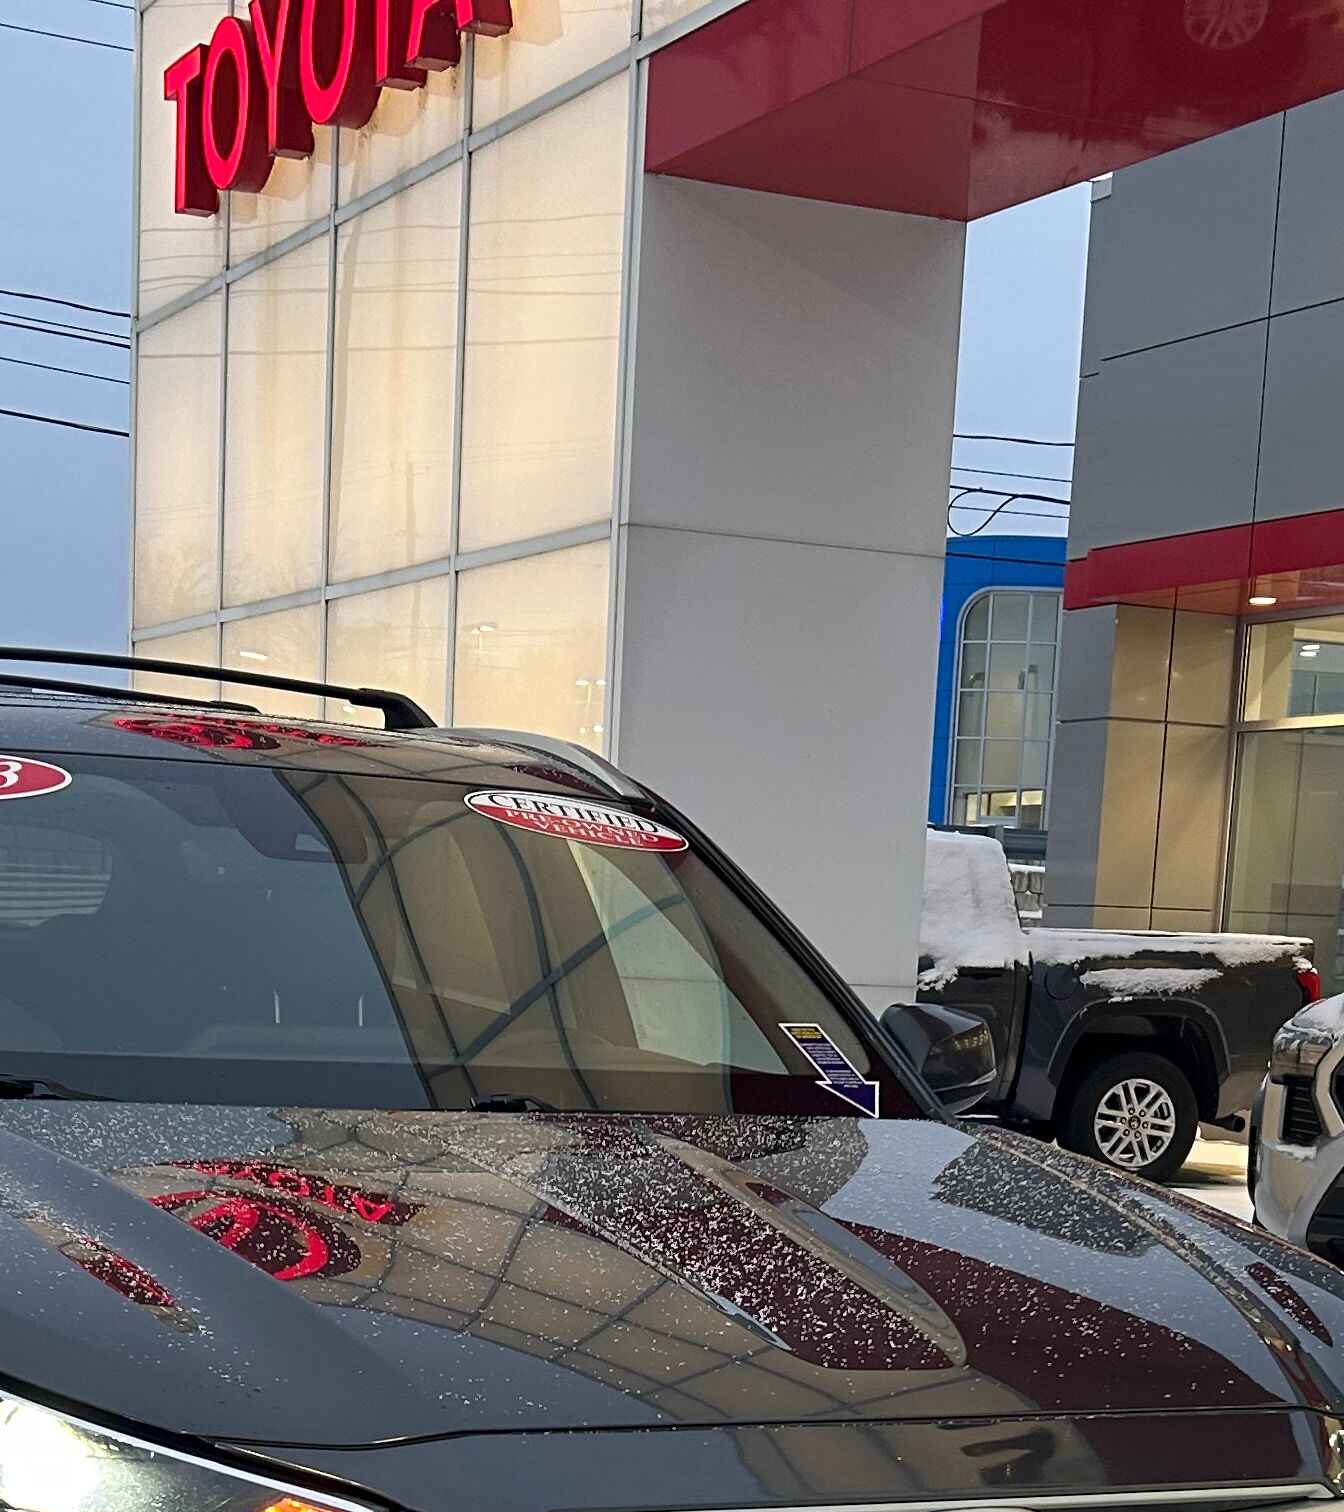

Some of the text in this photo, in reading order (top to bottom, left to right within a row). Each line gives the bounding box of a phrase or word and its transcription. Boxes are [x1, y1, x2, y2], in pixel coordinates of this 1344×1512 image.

[487, 794, 659, 834] CERTIFIED
[505, 809, 659, 842] PRE-OWNED
[533, 820, 644, 847] VEHICLE
